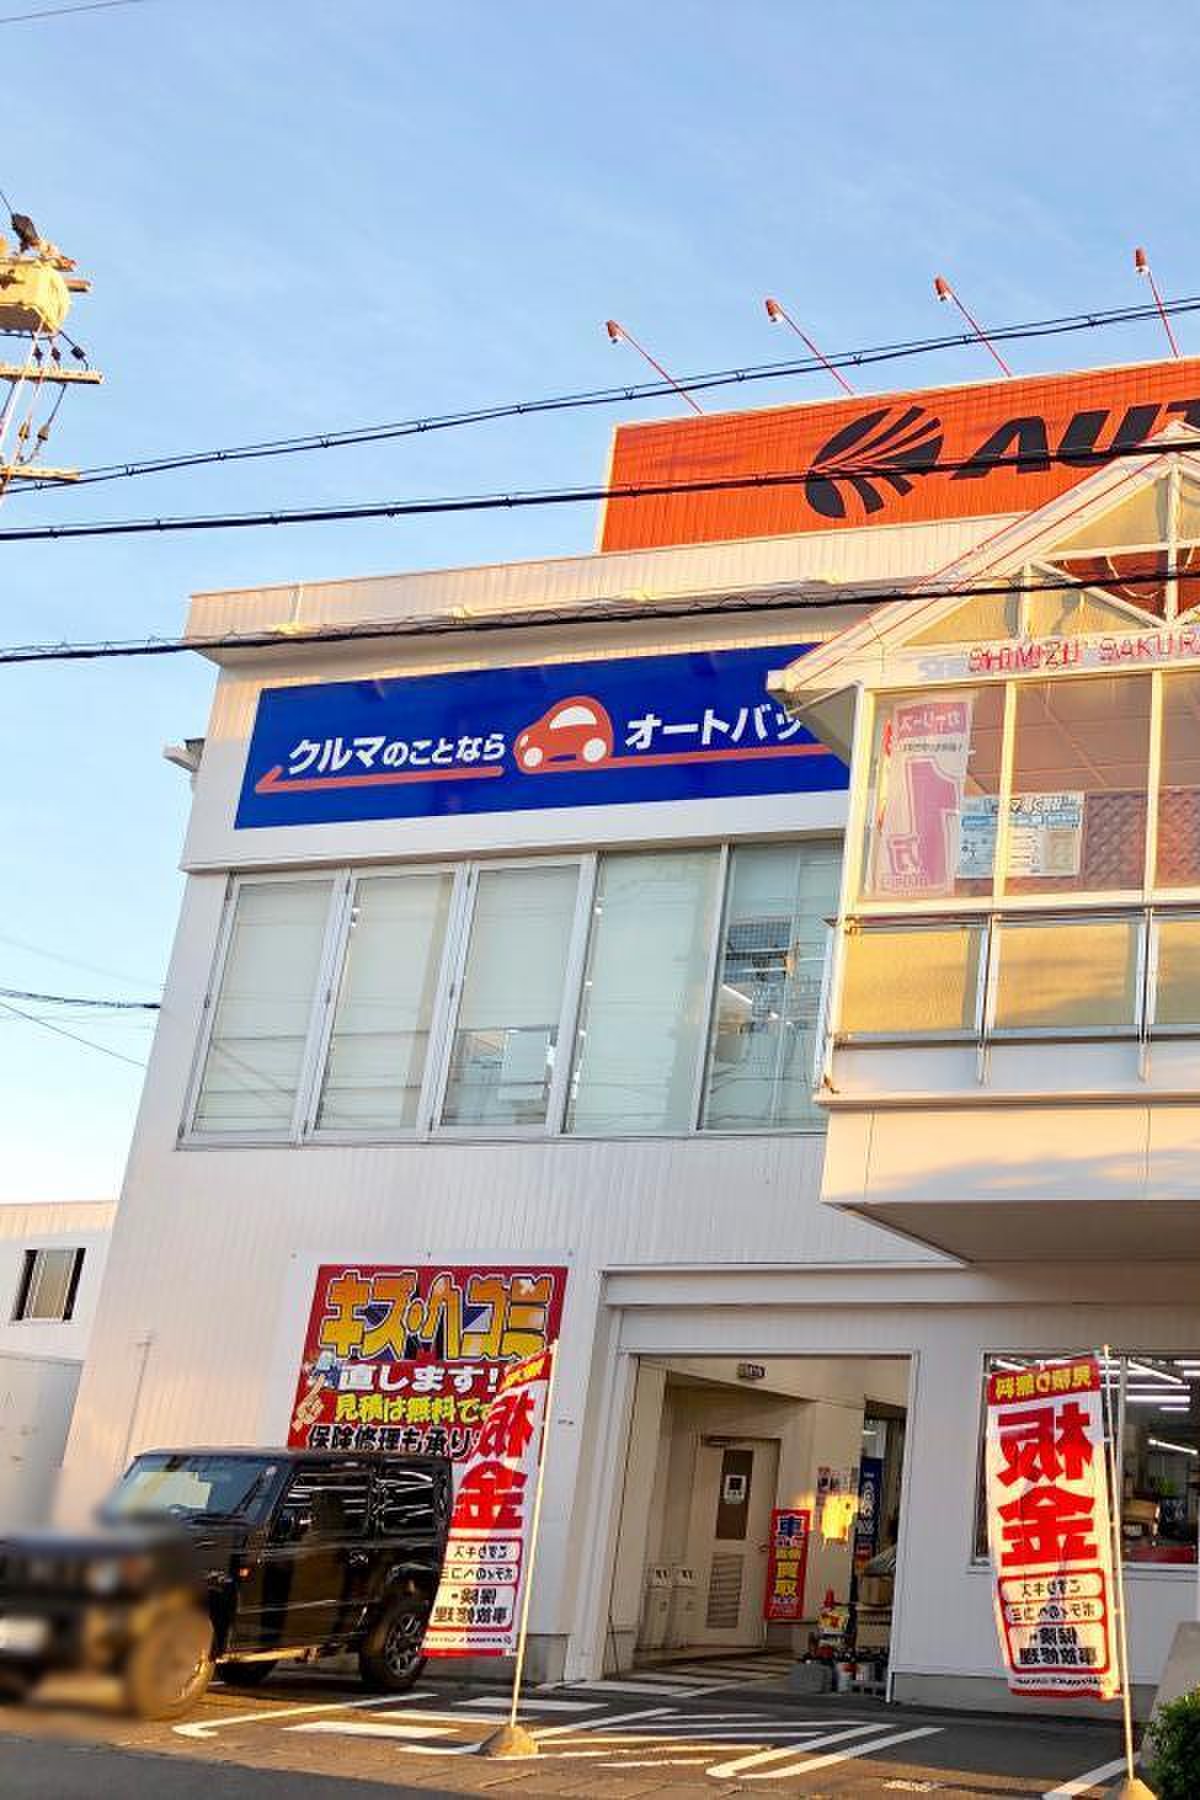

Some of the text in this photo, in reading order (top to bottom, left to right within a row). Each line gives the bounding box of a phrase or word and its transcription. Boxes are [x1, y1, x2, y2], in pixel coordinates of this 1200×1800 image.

[967, 637, 1082, 674] SHIMIZU
[287, 733, 506, 776] クルマのことなら
[308, 1424, 481, 1457] 保険修理も承り
